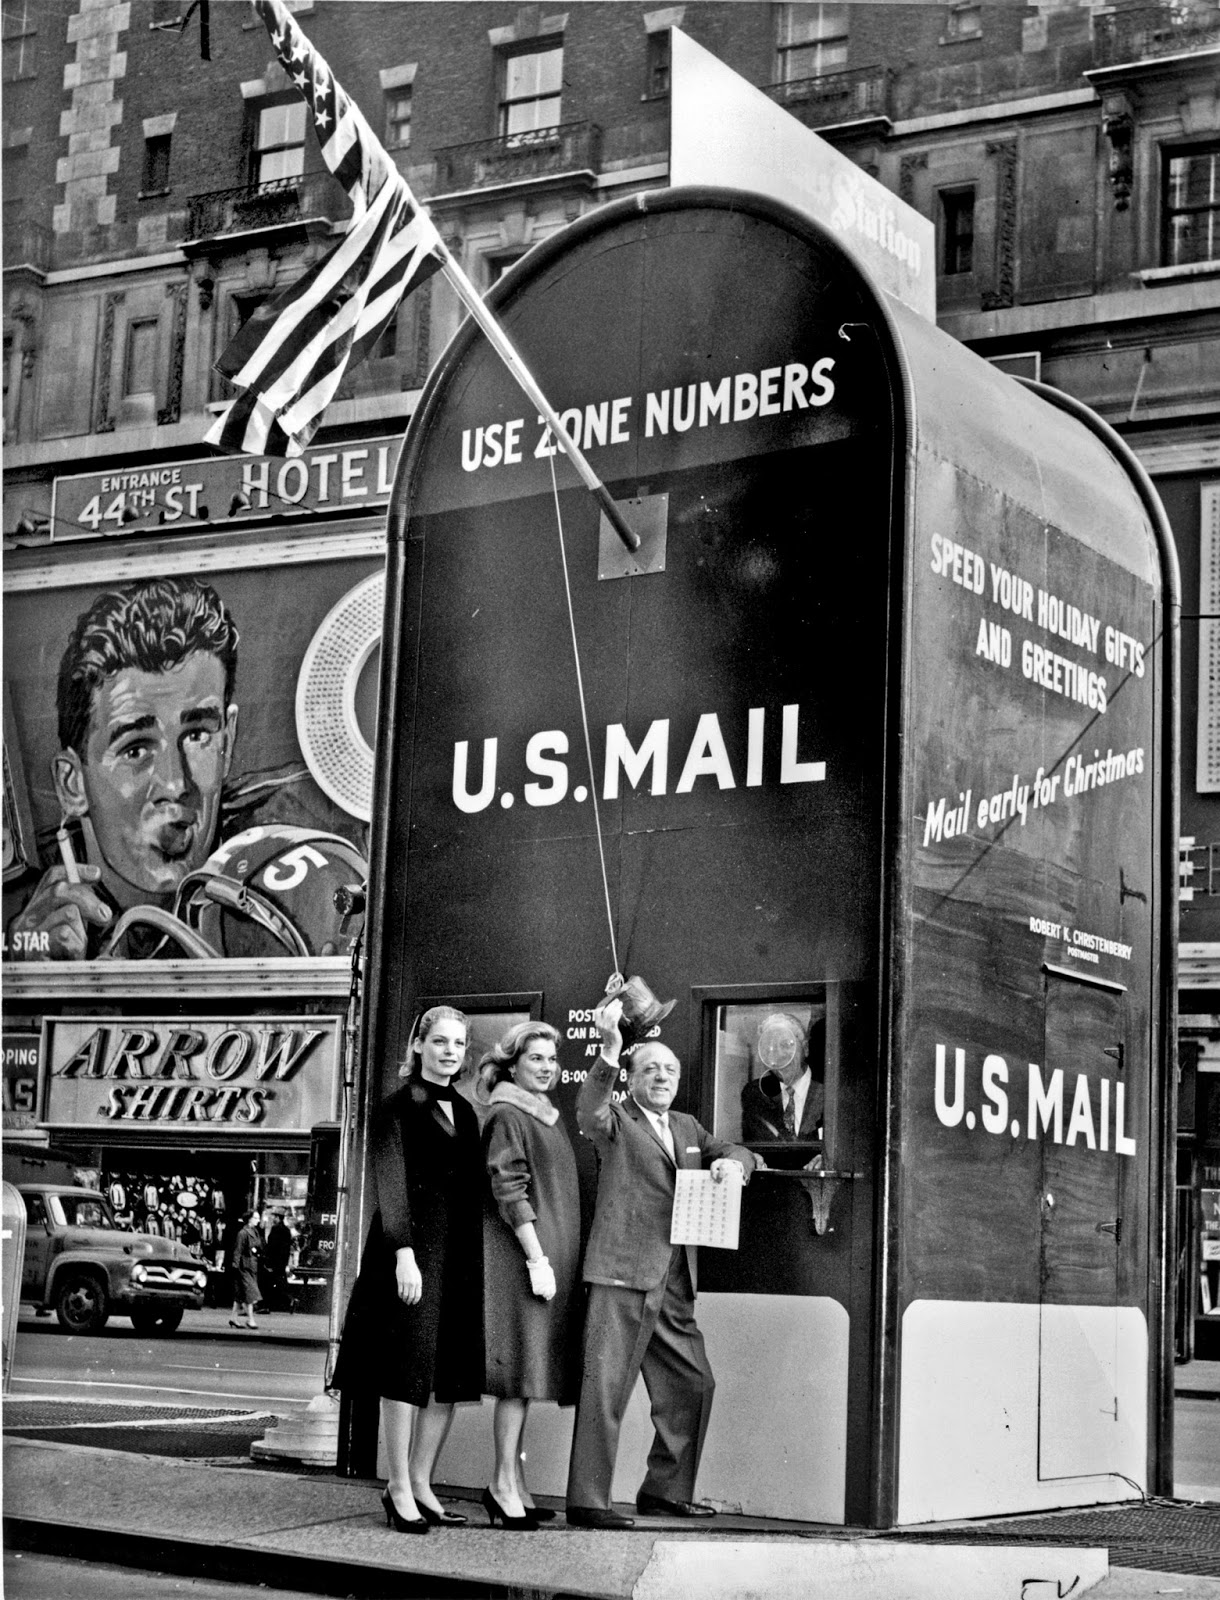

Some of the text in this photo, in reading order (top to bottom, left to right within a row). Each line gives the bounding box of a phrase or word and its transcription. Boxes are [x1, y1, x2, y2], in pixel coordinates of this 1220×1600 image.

[461, 357, 836, 472] USE ZONE NUMBERS
[101, 468, 181, 493] ENTRANCE
[242, 447, 394, 510] HOTEL
[164, 483, 203, 521] ST
[931, 532, 1145, 678] SPEED YOUR HOLIDAY GIFTS
[976, 618, 1107, 714] AND GREETINGS
[923, 747, 1144, 847] Mail early for Christmas
[263, 845, 329, 890] 5
[12, 931, 50, 951] STAR
[1029, 916, 1132, 960] ROBERT K. CHRISTENBERRY
[1067, 946, 1099, 964] POSTMASTER
[52, 1028, 322, 1081] ARROW
[566, 1027, 586, 1039] CAN
[585, 1044, 597, 1056] AT
[99, 1085, 268, 1123] SHIRTS
